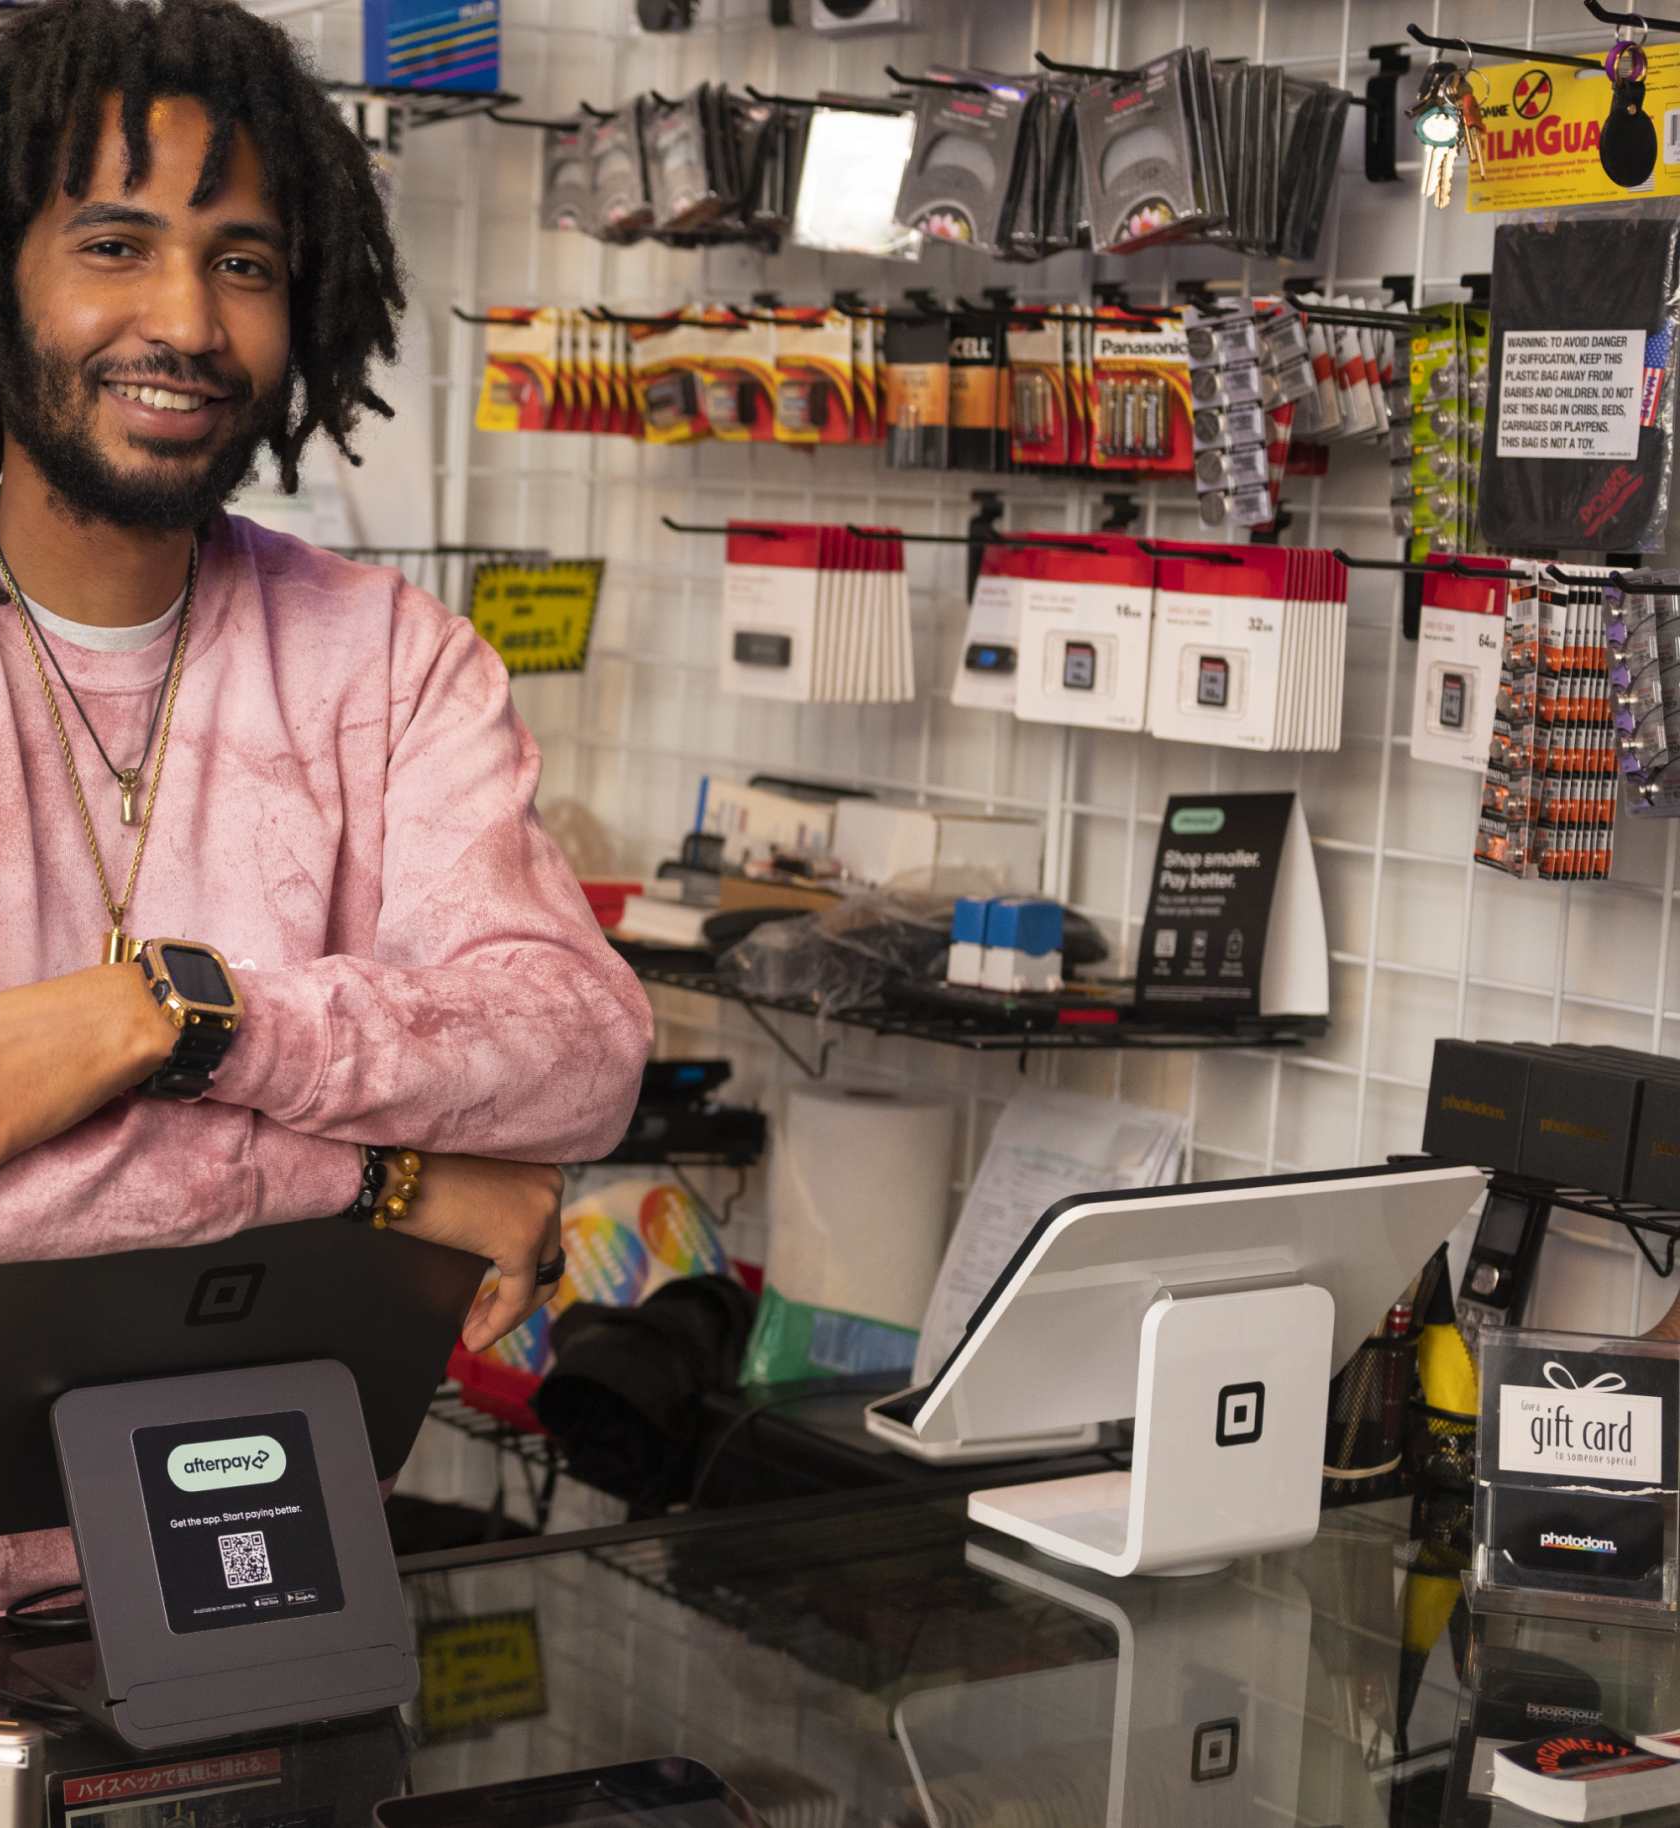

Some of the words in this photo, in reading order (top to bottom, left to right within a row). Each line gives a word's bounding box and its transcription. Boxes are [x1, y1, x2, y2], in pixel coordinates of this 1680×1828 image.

[1480, 104, 1510, 119] OMKE
[1539, 160, 1576, 170] unprocessed
[951, 336, 993, 360] CELL
[1100, 338, 1188, 357] Panasonic
[1507, 336, 1549, 348] WARNING:
[1550, 336, 1562, 348] TO
[1564, 336, 1590, 348] AVOID
[1592, 336, 1628, 348] DANGER
[1506, 353, 1518, 364] OF
[1519, 353, 1578, 366] SUFFOCATION,
[1579, 353, 1603, 364] KEEP
[1604, 352, 1623, 364] THIS
[1505, 370, 1540, 382] PLASTIC
[1541, 370, 1559, 382] BAG
[1560, 370, 1586, 382] AWAY
[1588, 370, 1613, 382] FROM
[1504, 386, 1534, 398] BABIES
[1535, 386, 1553, 398] AND
[1554, 386, 1600, 398] CHILDREN.
[1602, 386, 1614, 398] DO
[1616, 387, 1634, 398] NOT
[1640, 376, 1657, 419] MADE
[1503, 404, 1519, 416] USE
[1521, 404, 1539, 416] THIS
[1540, 404, 1558, 416] BAG
[1560, 404, 1570, 416] IN
[1571, 404, 1600, 417] CRIBS,
[1601, 404, 1626, 418] BEDS,
[1502, 420, 1548, 432] CARRIAGES
[1550, 420, 1562, 432] OR
[1564, 420, 1610, 432] PLAYPENS.
[1501, 436, 1520, 448] THIS
[1522, 436, 1538, 448] BAG
[1540, 436, 1548, 448] IS
[1550, 436, 1568, 449] NOT
[1569, 437, 1576, 448] A
[1577, 437, 1595, 450] TOY.
[1579, 464, 1633, 525] DOMKE
[1248, 617, 1274, 632] 32GB
[1478, 633, 1497, 649] 64GB
[1163, 849, 1202, 870] Shop
[1204, 849, 1261, 868] smaller.
[1160, 870, 1188, 893] Pay
[1190, 872, 1236, 890] better.
[1442, 1094, 1506, 1120] photodom.
[1540, 1116, 1610, 1142] photodom.
[1520, 1400, 1535, 1412] Give
[1536, 1404, 1540, 1412] a
[1530, 1404, 1574, 1455] gift
[1582, 1410, 1632, 1453] card
[184, 1454, 251, 1474] afterpay
[1555, 1452, 1564, 1460] to
[1567, 1452, 1604, 1464] someone
[1606, 1454, 1637, 1466] special
[170, 1519, 187, 1528] Get
[187, 1517, 202, 1526] the
[202, 1516, 222, 1526] app.
[222, 1512, 244, 1522] Start
[245, 1508, 274, 1521] paying
[275, 1504, 302, 1516] better.
[1540, 1532, 1618, 1551] photodom.
[193, 1606, 216, 1614] Available
[235, 1602, 248, 1610] here.
[1536, 1737, 1634, 1774] DOCUMENT
[77, 1754, 269, 1800] ハイスペックで気軽に撮れる。
